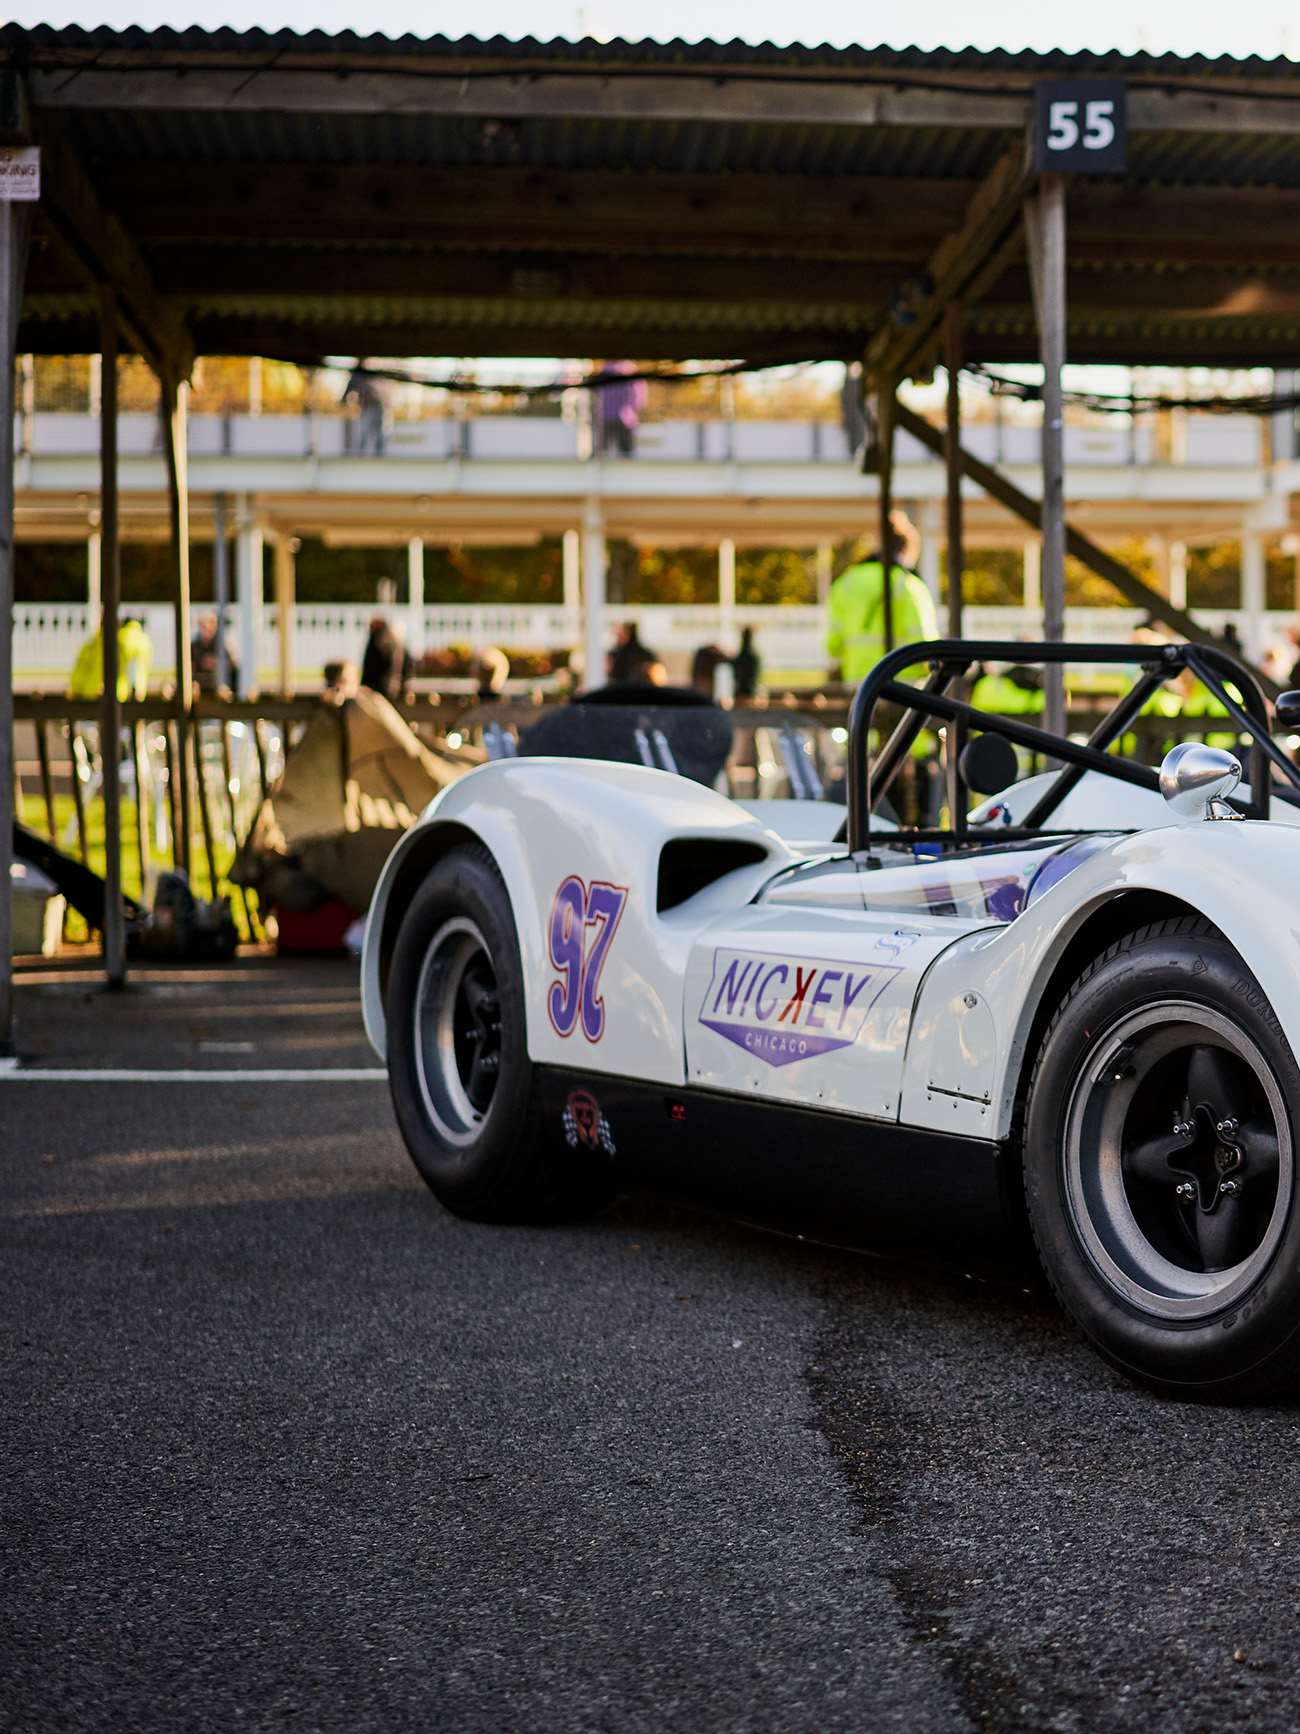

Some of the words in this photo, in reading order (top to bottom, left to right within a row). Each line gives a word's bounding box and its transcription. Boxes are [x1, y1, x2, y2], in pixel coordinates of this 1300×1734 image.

[1046, 100, 1115, 151] 55
[547, 874, 629, 1043] 97
[712, 959, 872, 1031] NICKEY
[1231, 976, 1296, 1067] DUNLO
[744, 1032, 808, 1055] CHICAGO
